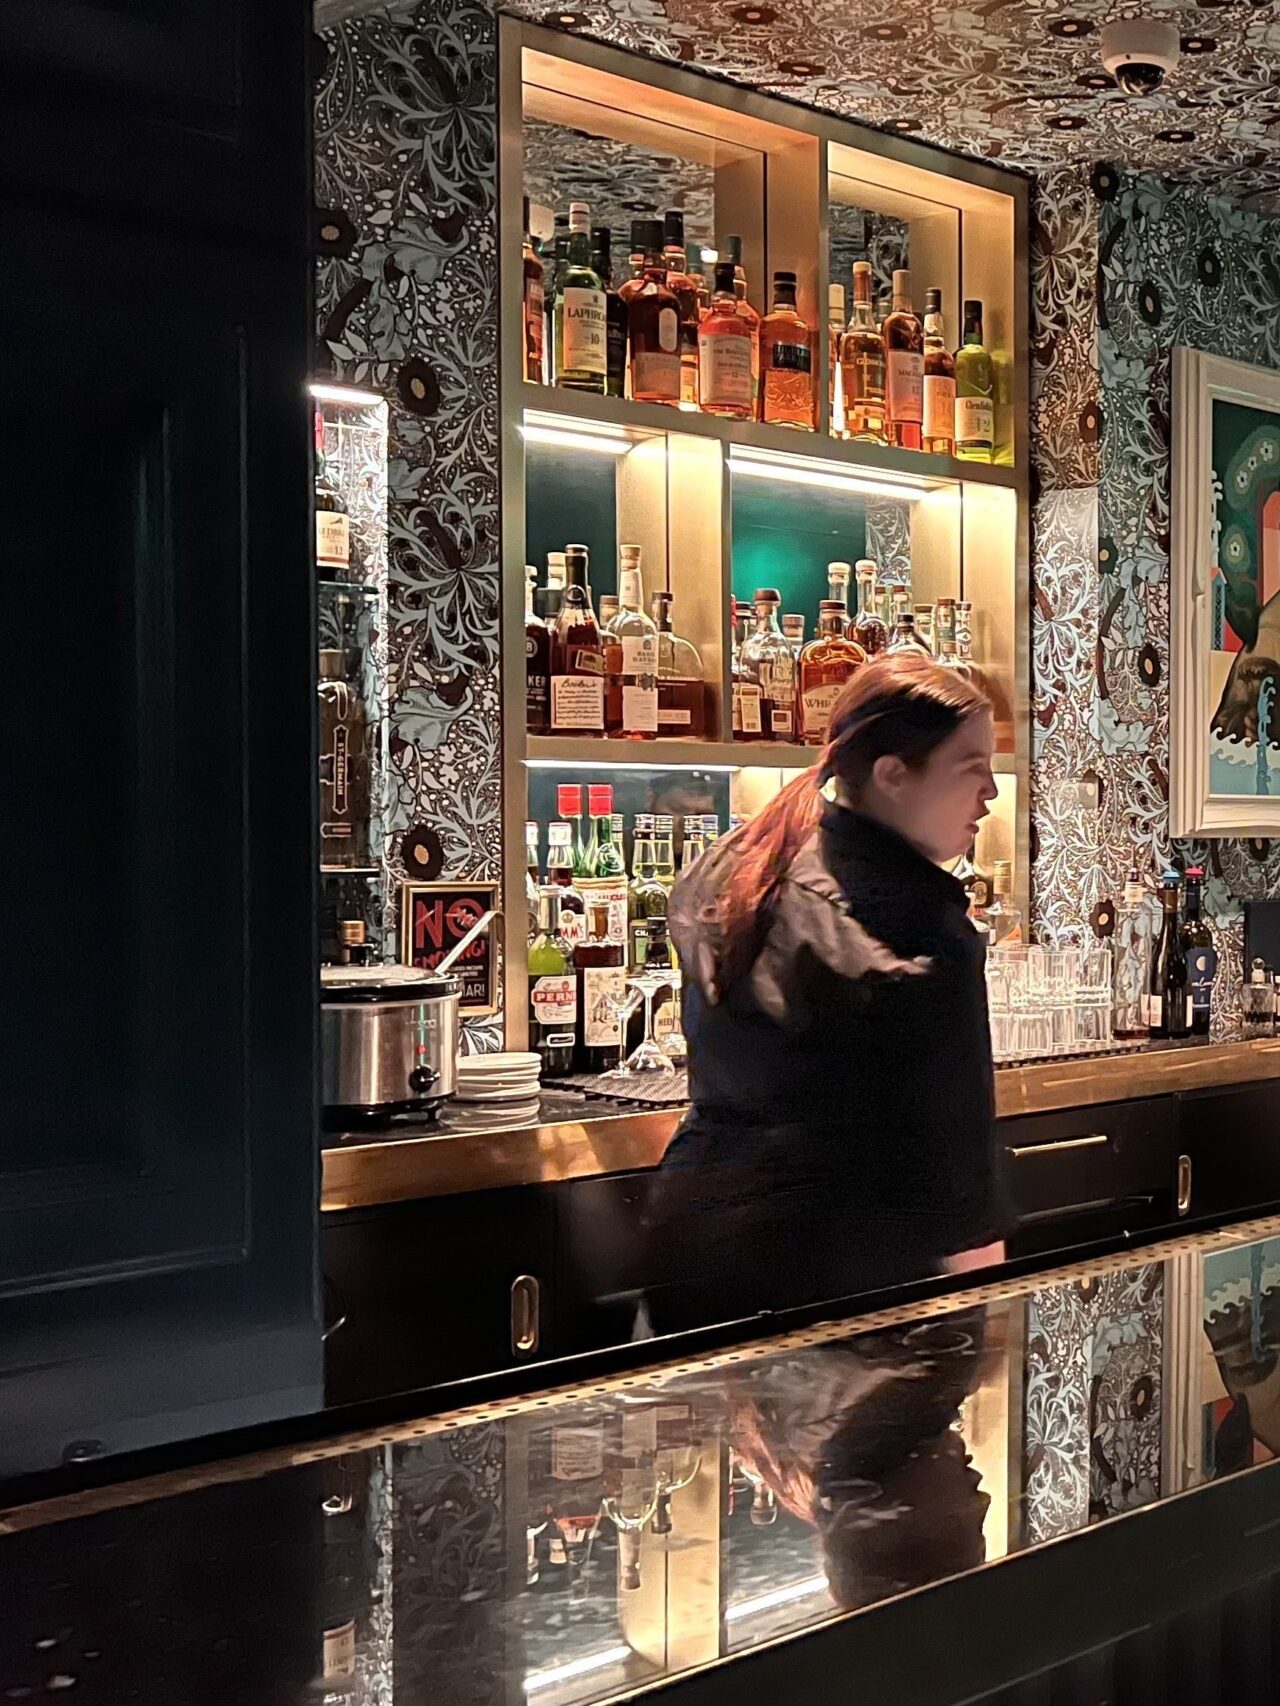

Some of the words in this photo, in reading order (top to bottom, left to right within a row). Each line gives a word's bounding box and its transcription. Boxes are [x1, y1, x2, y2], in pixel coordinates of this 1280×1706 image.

[590, 333, 600, 345] 10
[977, 416, 991, 433] 12
[416, 898, 485, 949] NO
